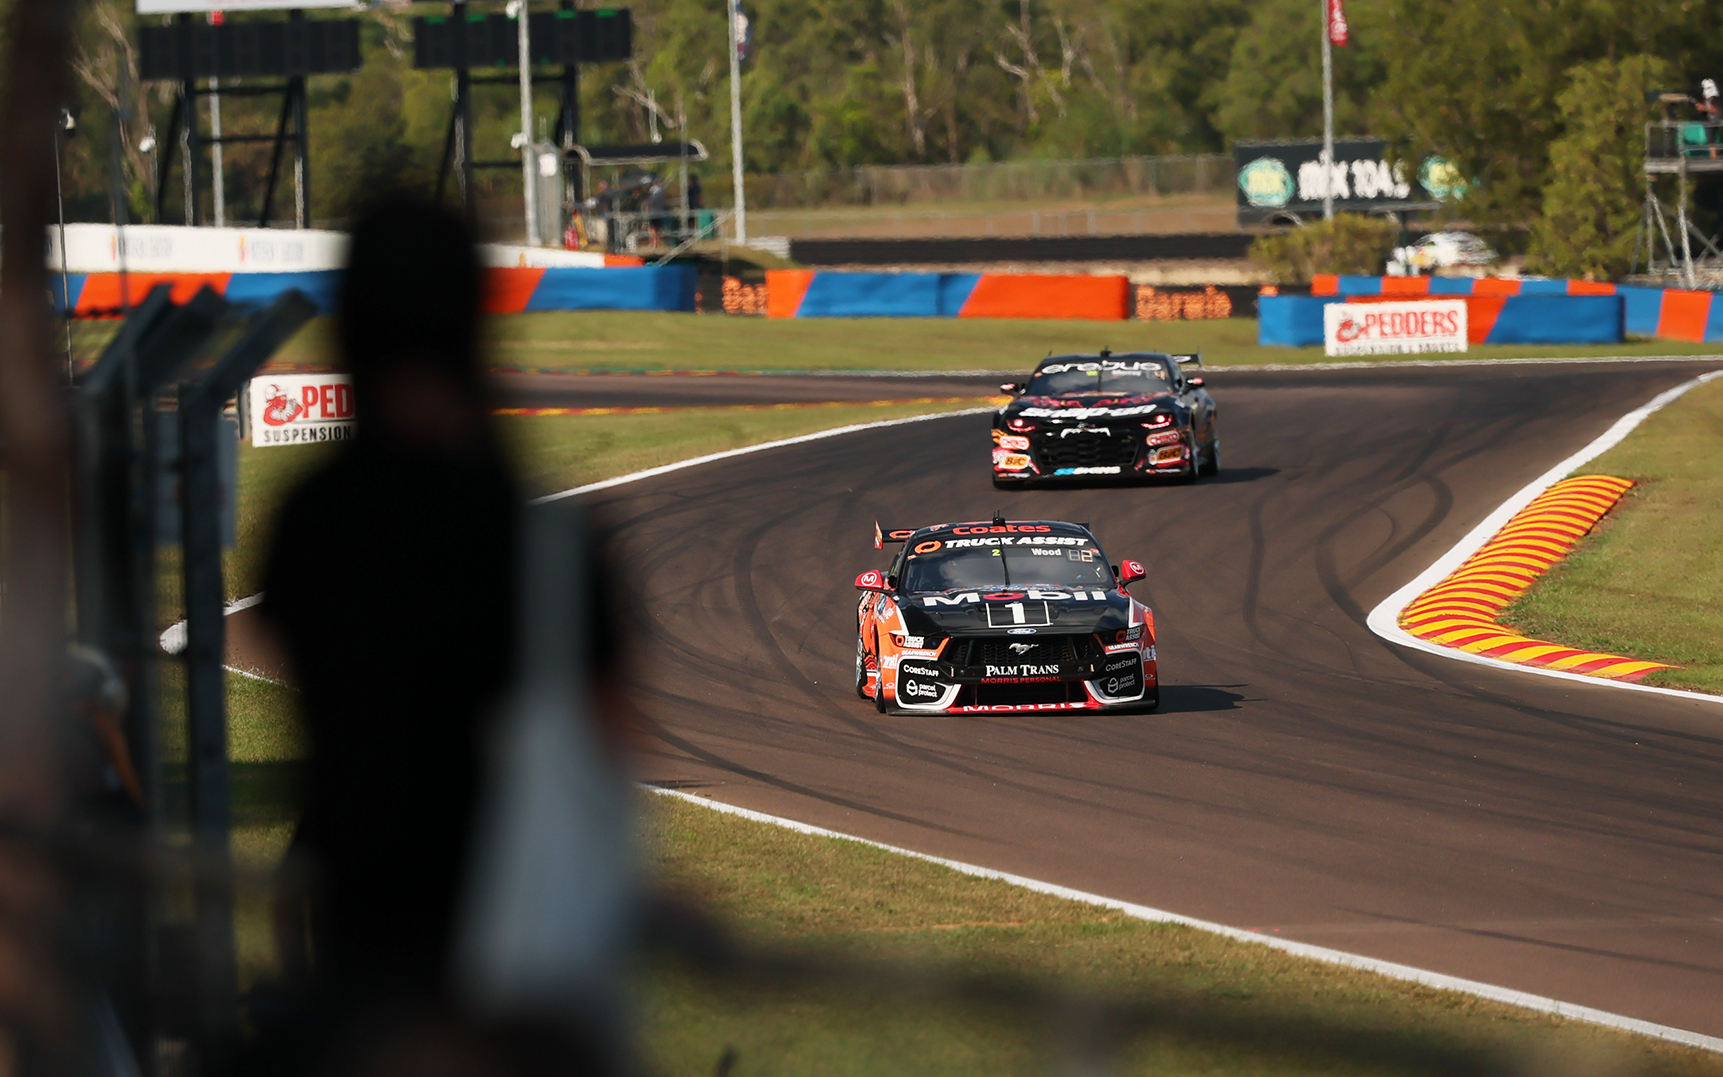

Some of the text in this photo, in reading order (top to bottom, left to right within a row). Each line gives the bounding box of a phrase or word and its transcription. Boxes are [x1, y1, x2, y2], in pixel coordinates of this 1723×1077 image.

[1364, 310, 1458, 337] PEDDERS
[302, 384, 355, 419] PED
[945, 537, 1088, 549] TRUCK ASSIST
[1031, 548, 1062, 556] Wood
[922, 590, 1107, 607] Mobil
[1004, 603, 1026, 624] 1
[985, 664, 1060, 677] PALM TRANS
